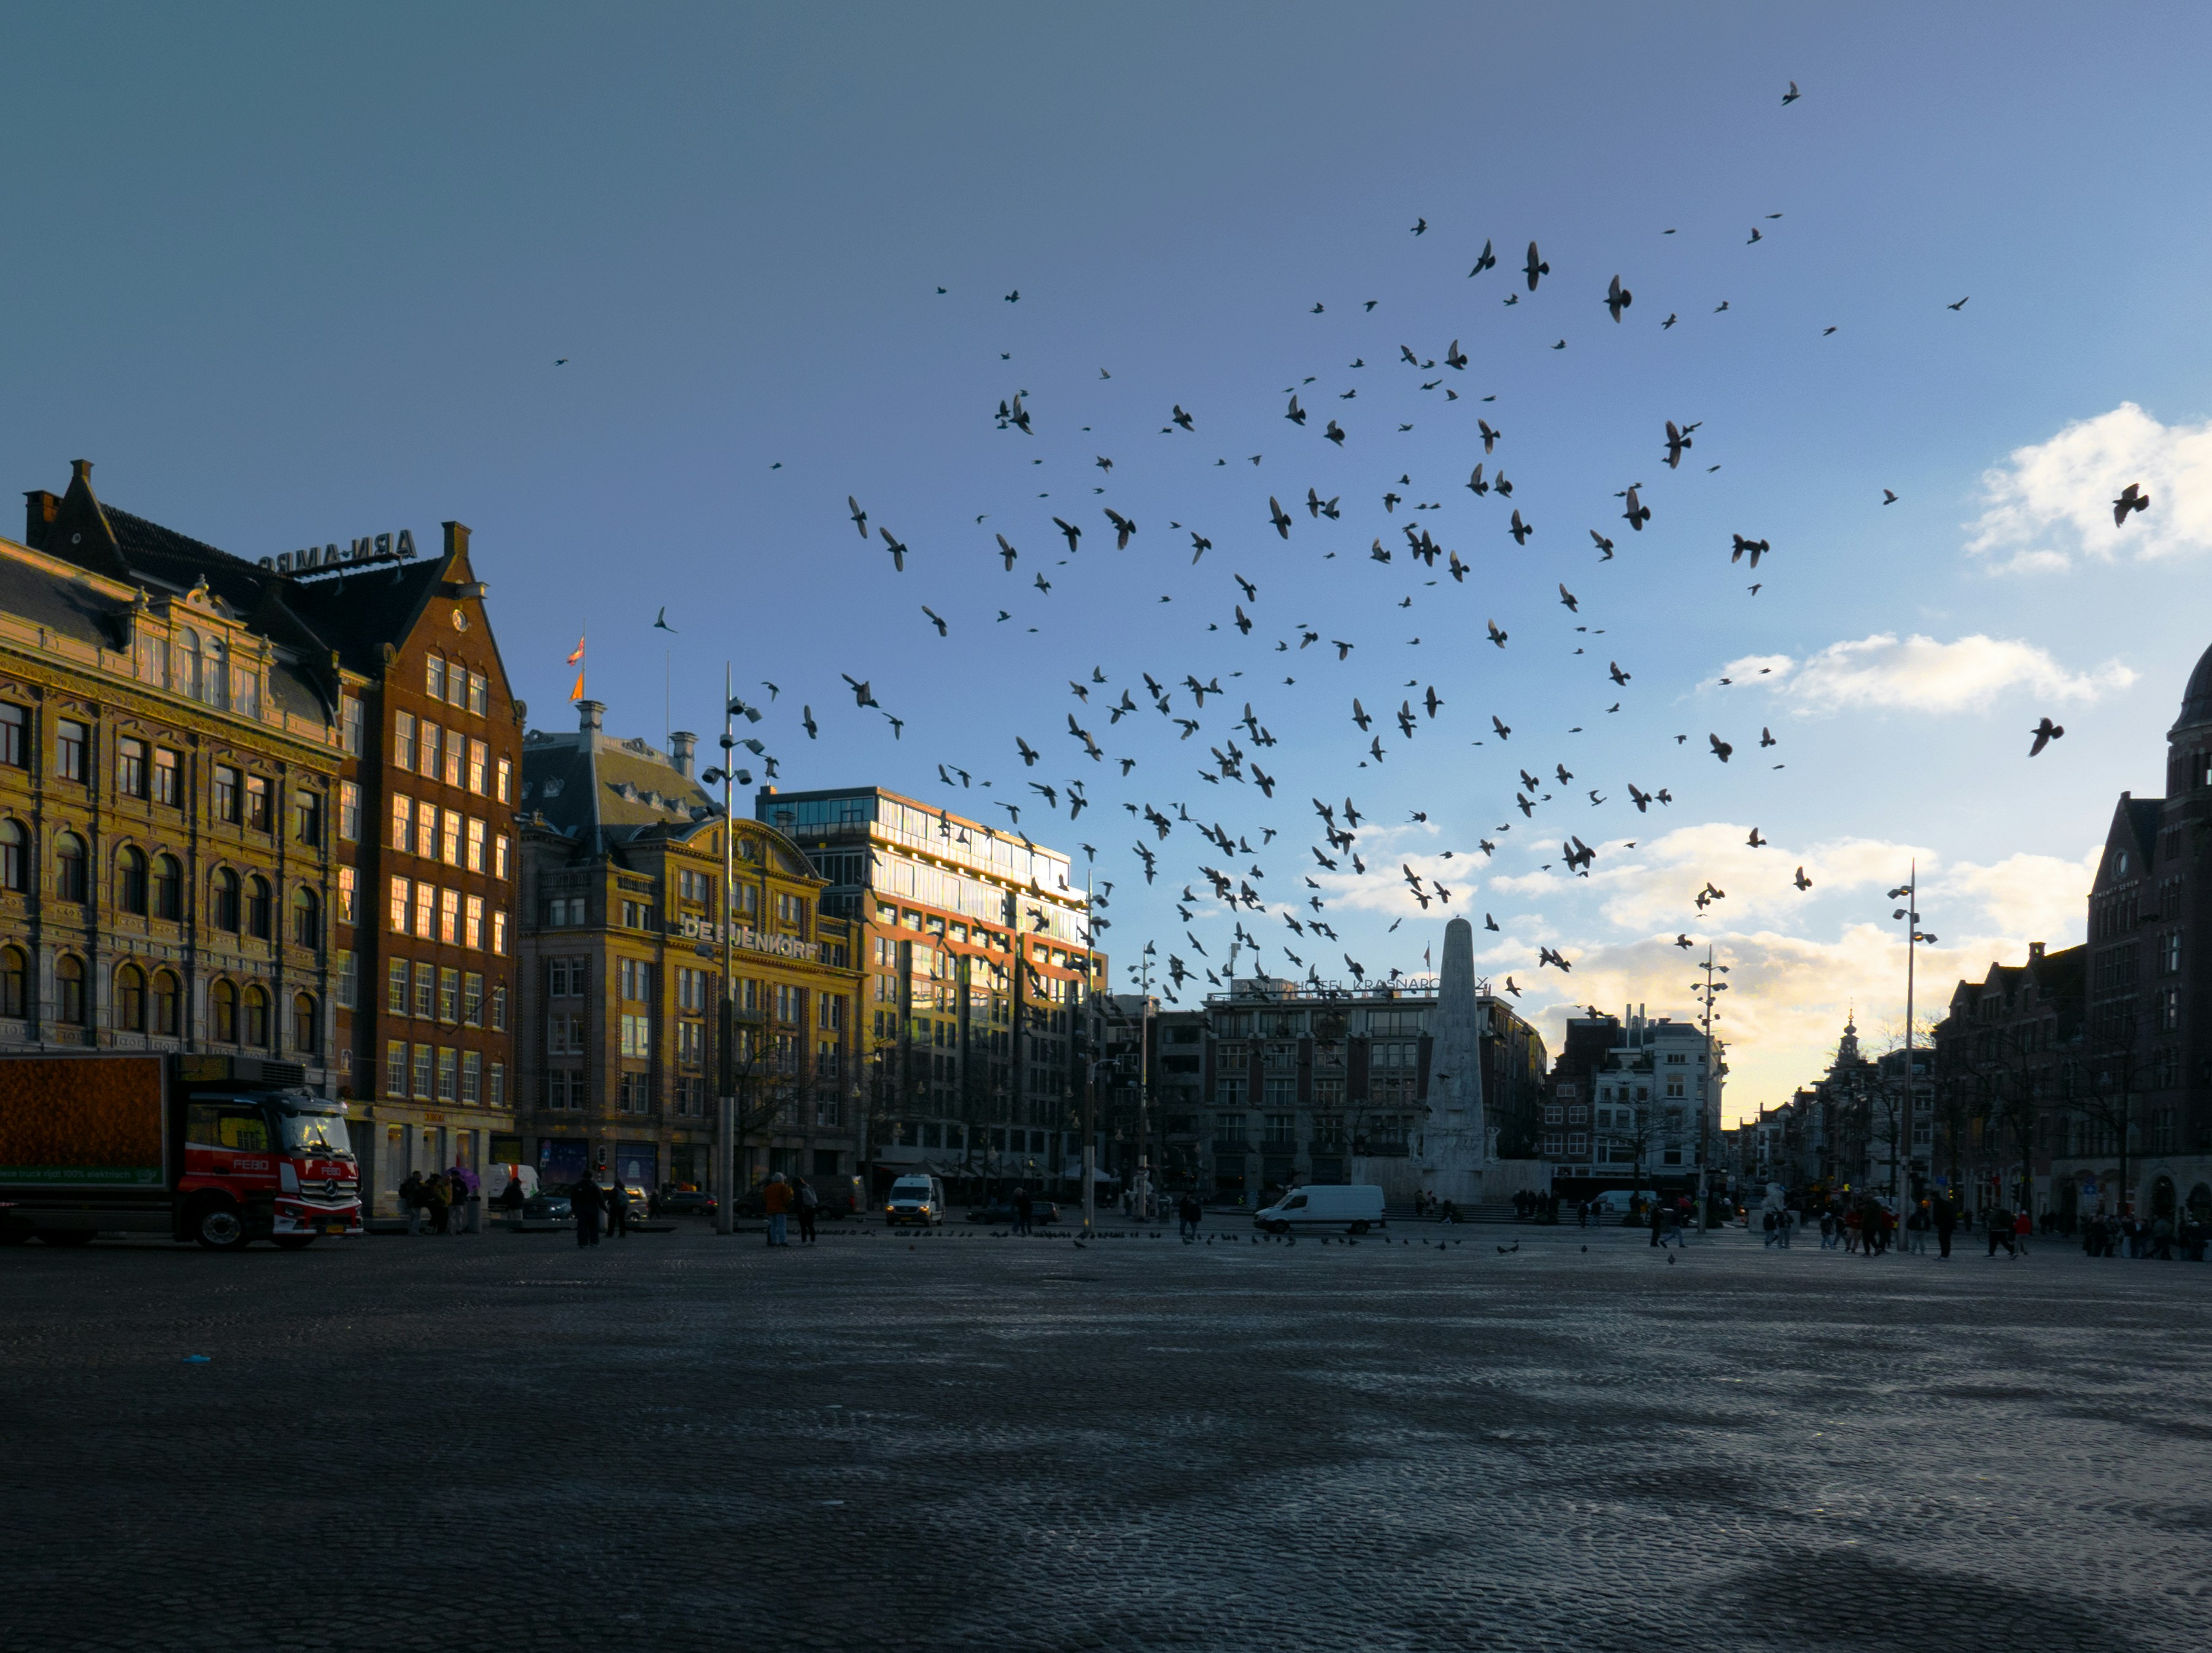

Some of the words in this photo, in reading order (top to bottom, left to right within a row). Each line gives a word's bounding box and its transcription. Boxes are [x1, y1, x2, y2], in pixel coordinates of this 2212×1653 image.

[684, 918, 714, 942] DE
[716, 924, 818, 959] BJENKORF
[1293, 979, 1347, 992] HOTEL
[1353, 977, 1488, 991] KRASNAPOY
[233, 1159, 269, 1171] FEBO
[320, 1166, 341, 1176] FEBO
[44, 1169, 61, 1180] rijdt
[63, 1169, 85, 1178] 100%
[87, 1170, 131, 1179] elektrisch
